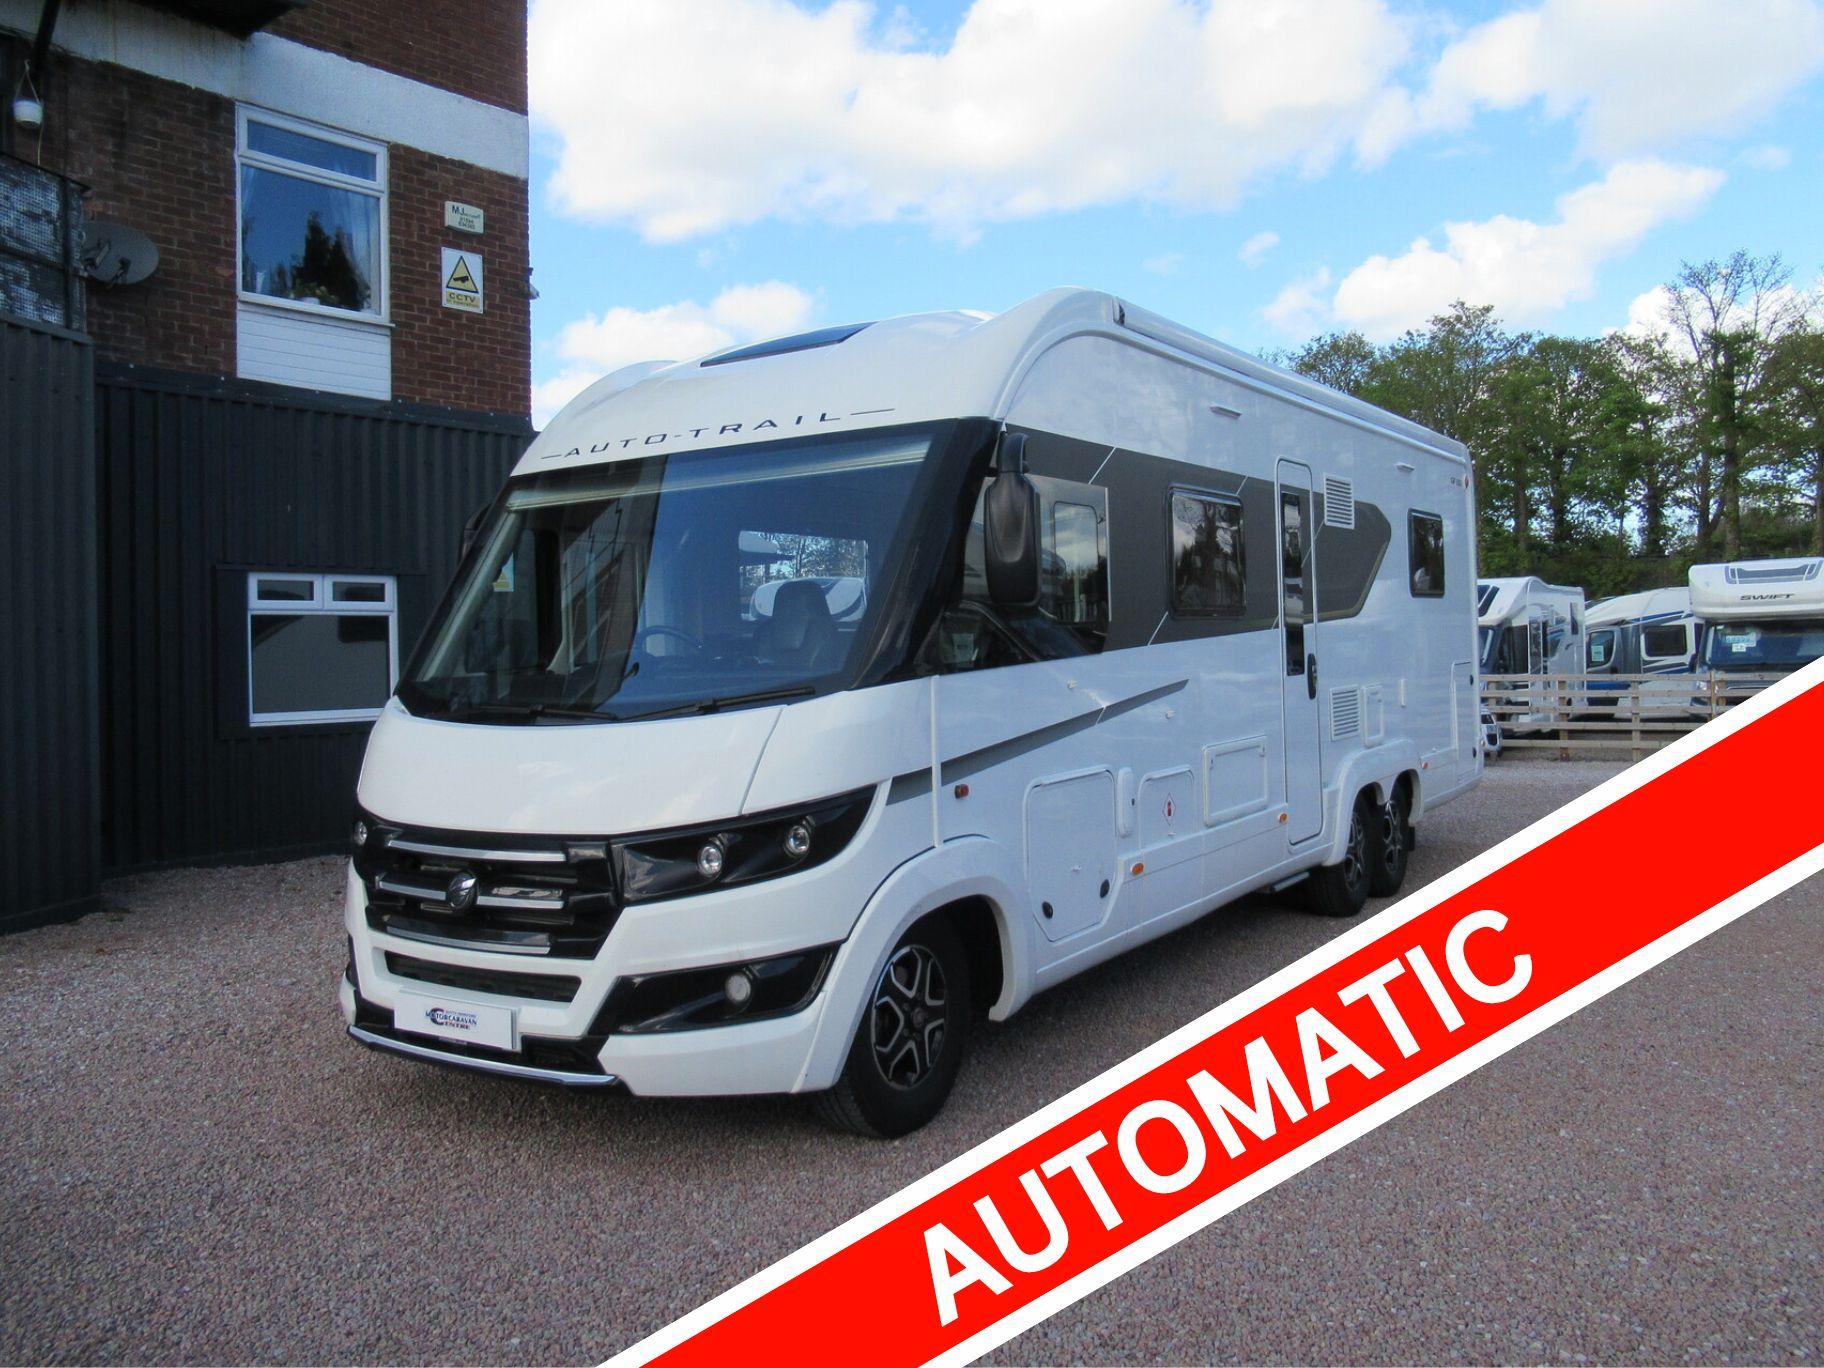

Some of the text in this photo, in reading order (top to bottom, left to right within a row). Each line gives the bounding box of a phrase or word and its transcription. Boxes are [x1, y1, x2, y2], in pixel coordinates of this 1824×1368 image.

[449, 292, 476, 303] CCTV
[563, 412, 841, 457] AUTO-TRAIL
[1740, 593, 1795, 601] SWIFT
